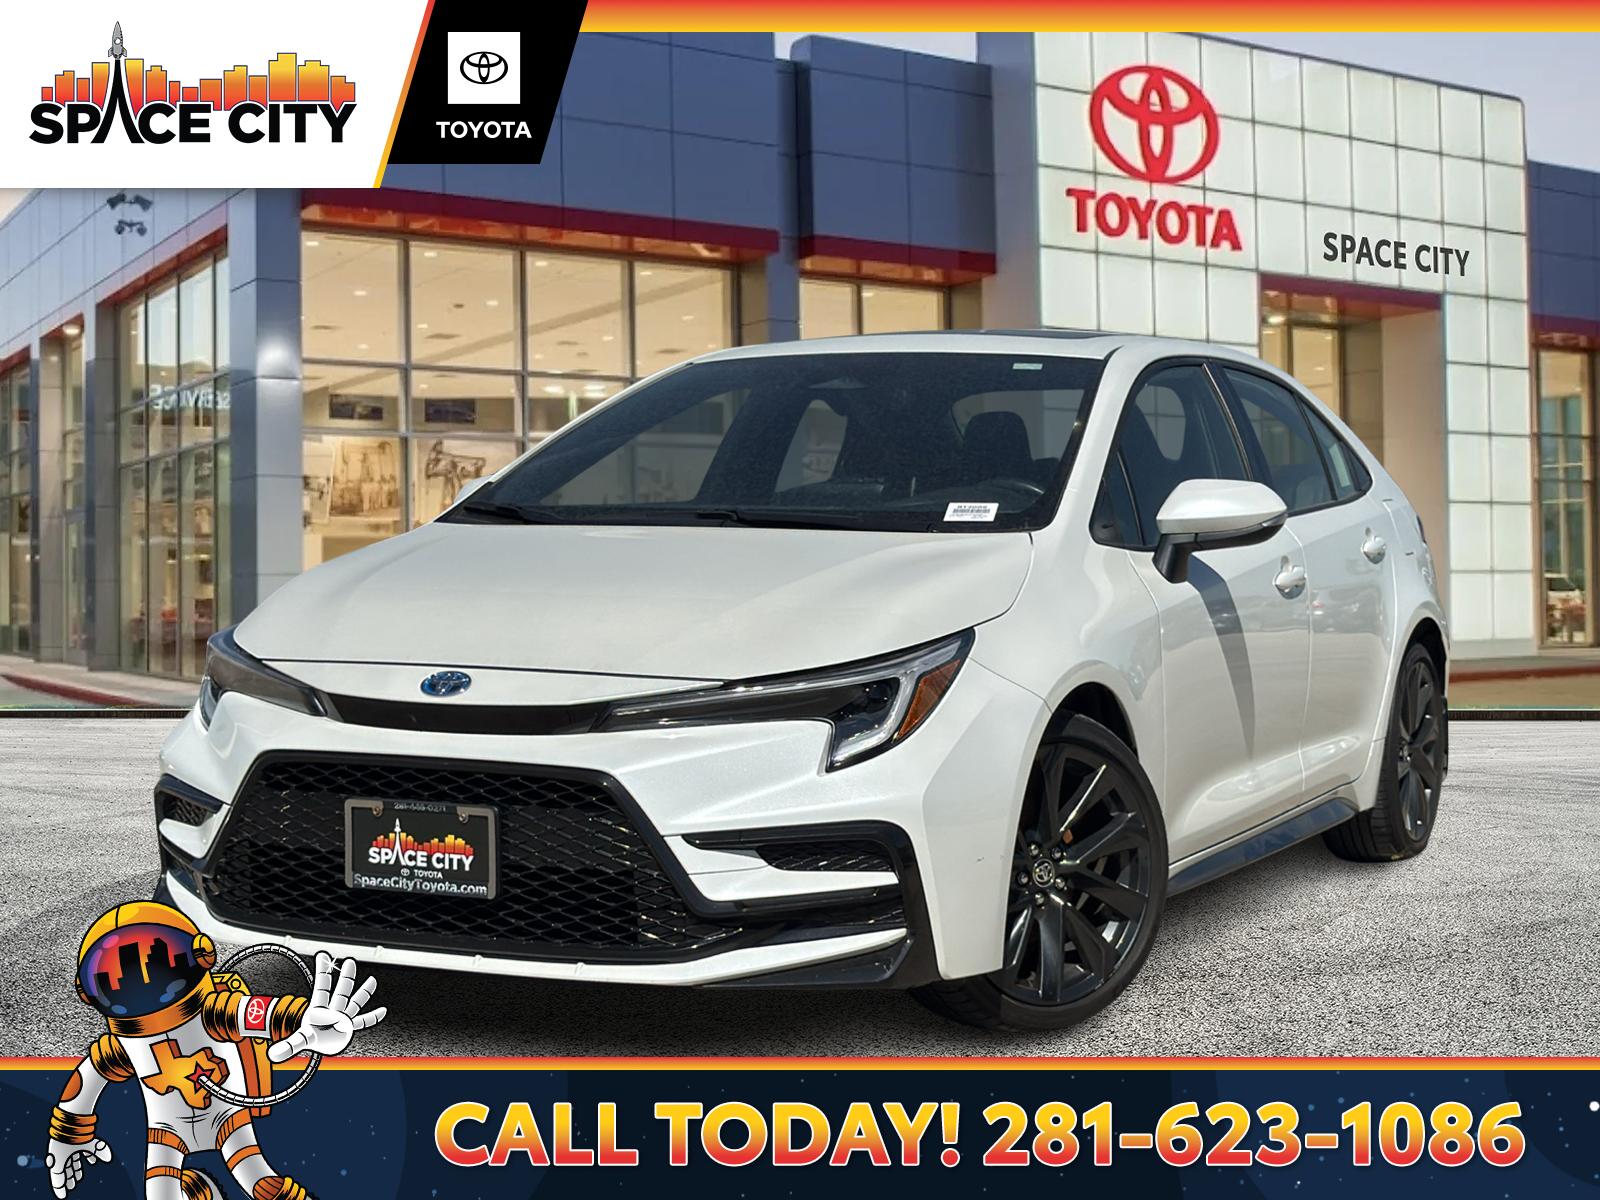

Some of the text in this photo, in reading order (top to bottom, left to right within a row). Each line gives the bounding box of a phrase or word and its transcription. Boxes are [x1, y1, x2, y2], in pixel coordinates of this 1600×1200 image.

[1067, 187, 1242, 251] TOYOTA
[1323, 231, 1470, 277] SPACE CITY
[368, 833, 474, 871] SPACE CITY
[354, 873, 487, 895] SpaceCityToyota.com
[414, 869, 443, 879] TOYOTA
